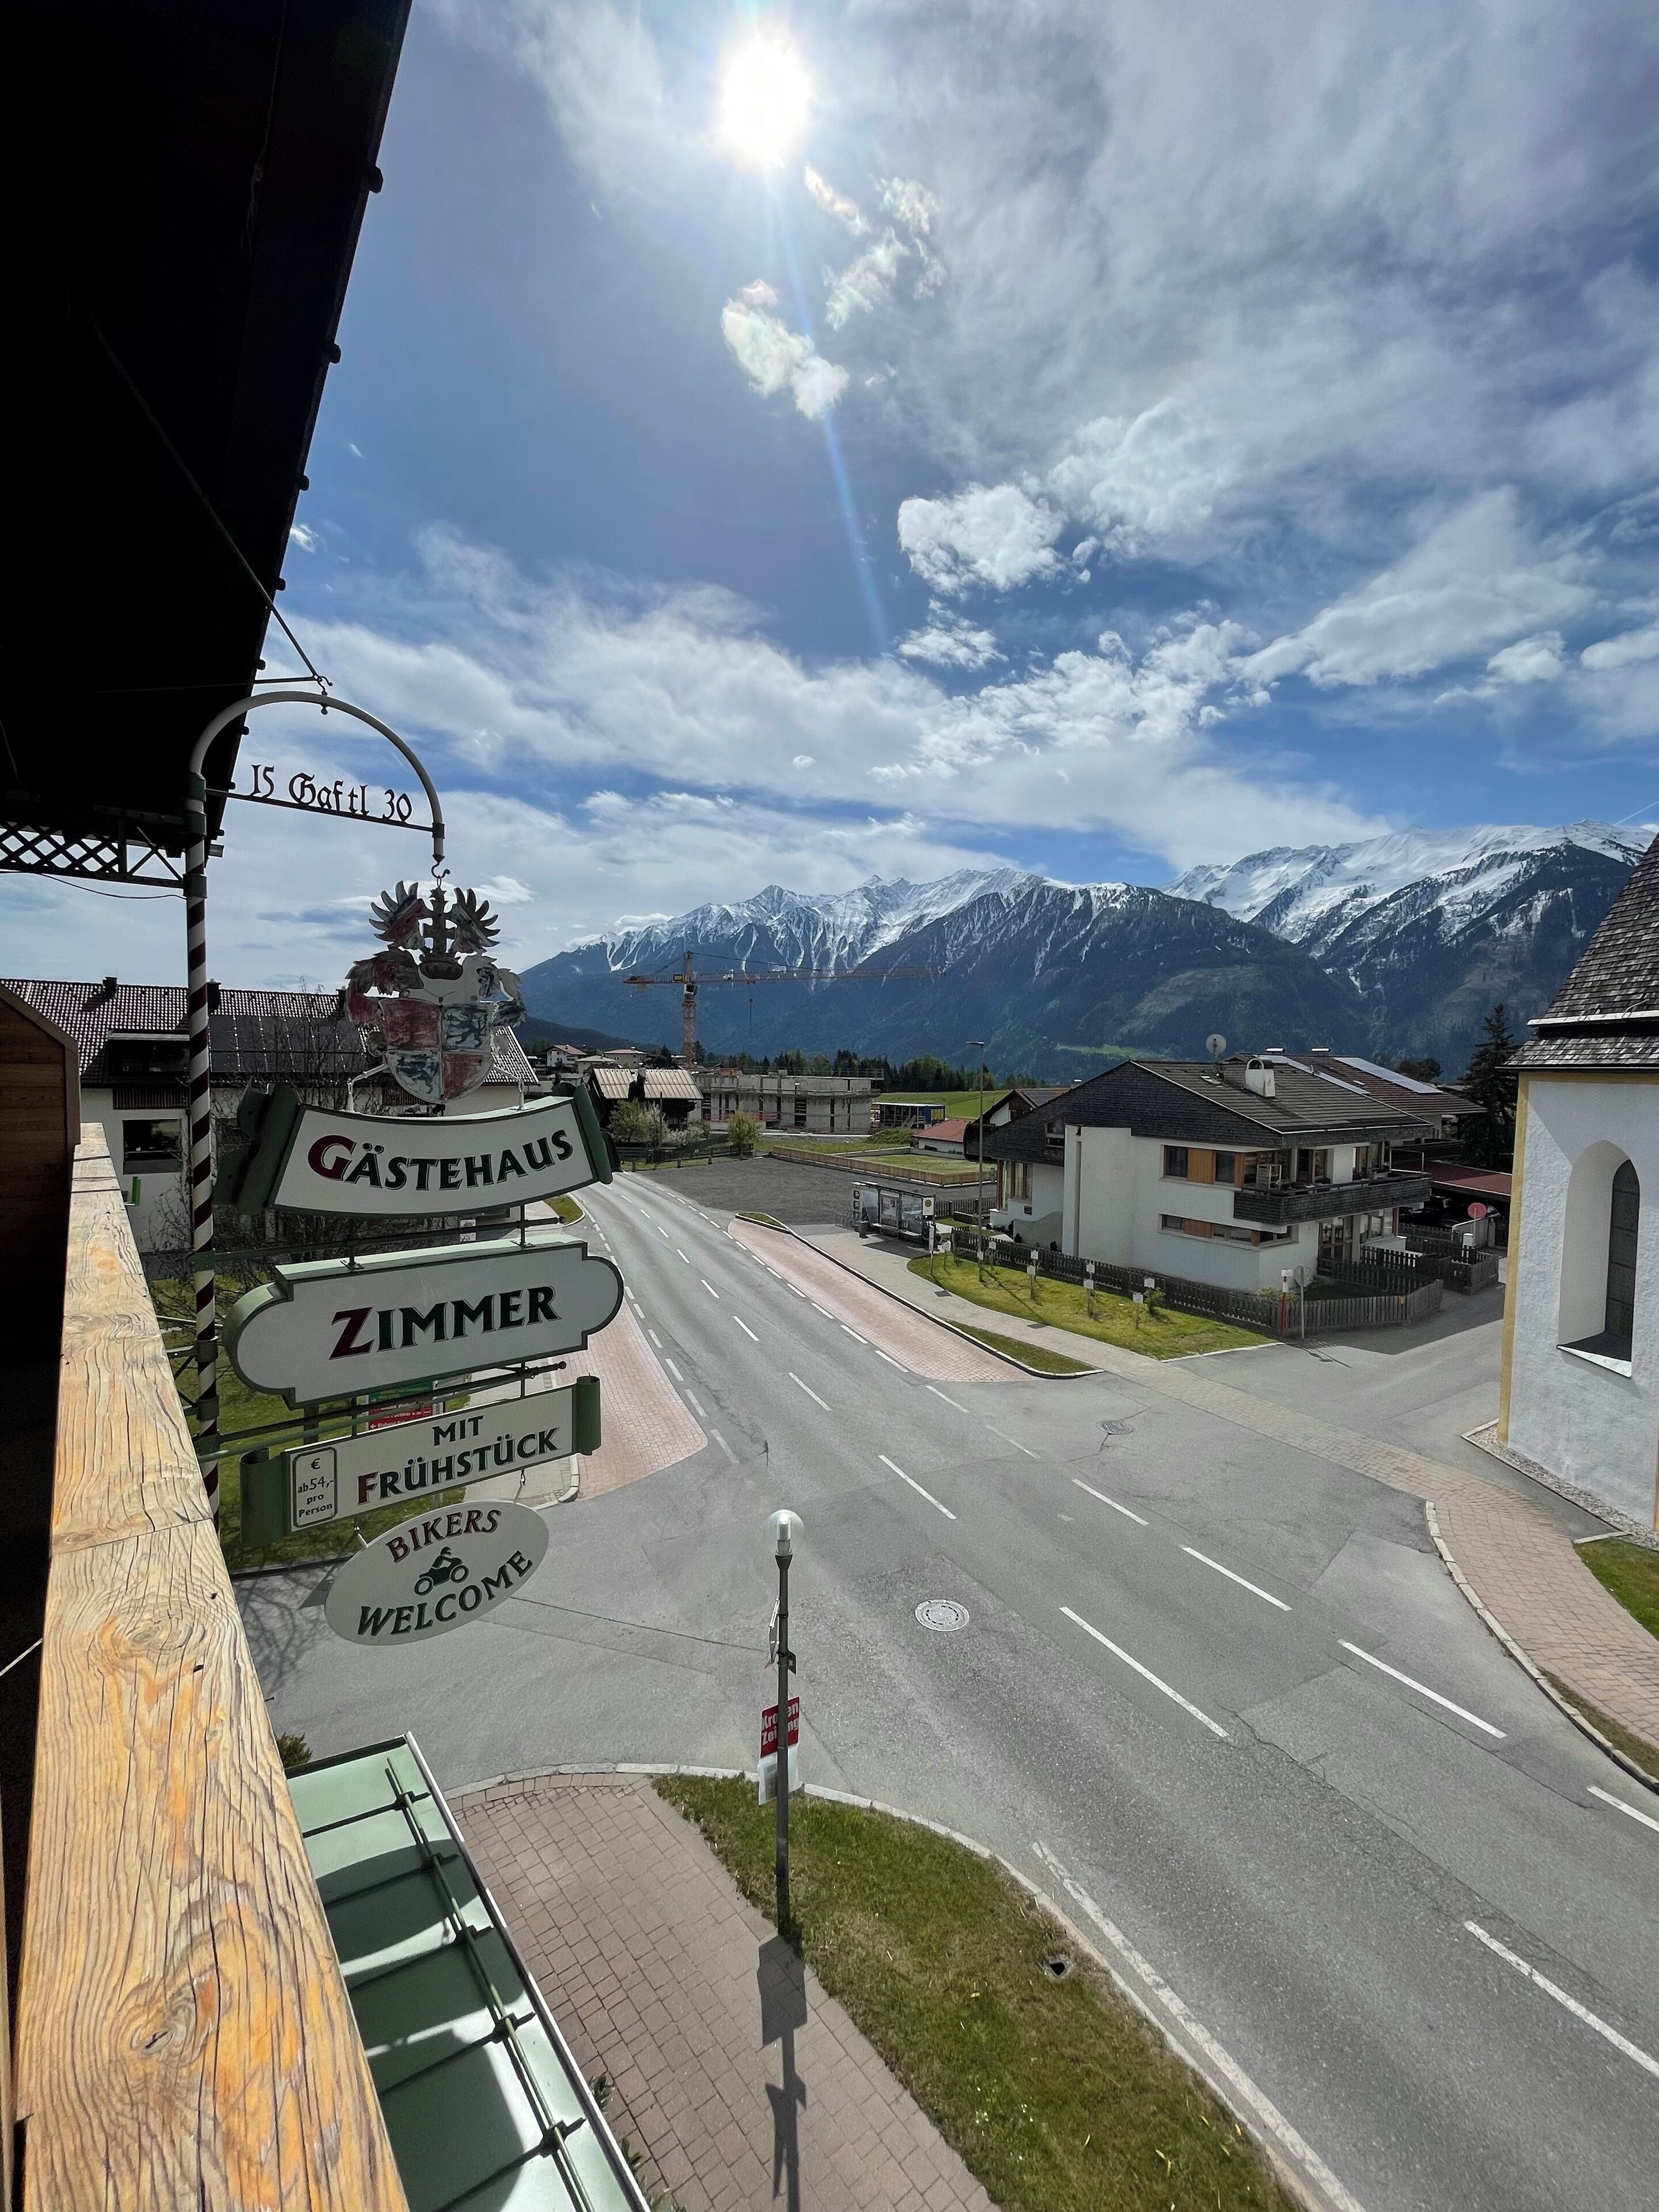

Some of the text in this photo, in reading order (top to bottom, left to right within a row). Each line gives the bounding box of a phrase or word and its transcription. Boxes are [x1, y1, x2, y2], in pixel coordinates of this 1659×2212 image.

[250, 764, 275, 797] 15
[382, 789, 412, 822] 30
[308, 1129, 573, 1191] GÄSTEHAUS
[329, 1285, 561, 1360] ZIMMER
[431, 1415, 484, 1446] MIT
[310, 1458, 321, 1470] €
[357, 1427, 561, 1505] FRÜHSTÜCK
[298, 1503, 333, 1518] Person
[306, 1494, 324, 1505] pro
[385, 1509, 502, 1563] BIKERS
[357, 1550, 534, 1637] WELCOME
[762, 1702, 798, 1730] Kroen
[762, 1717, 799, 1746] Zeing
